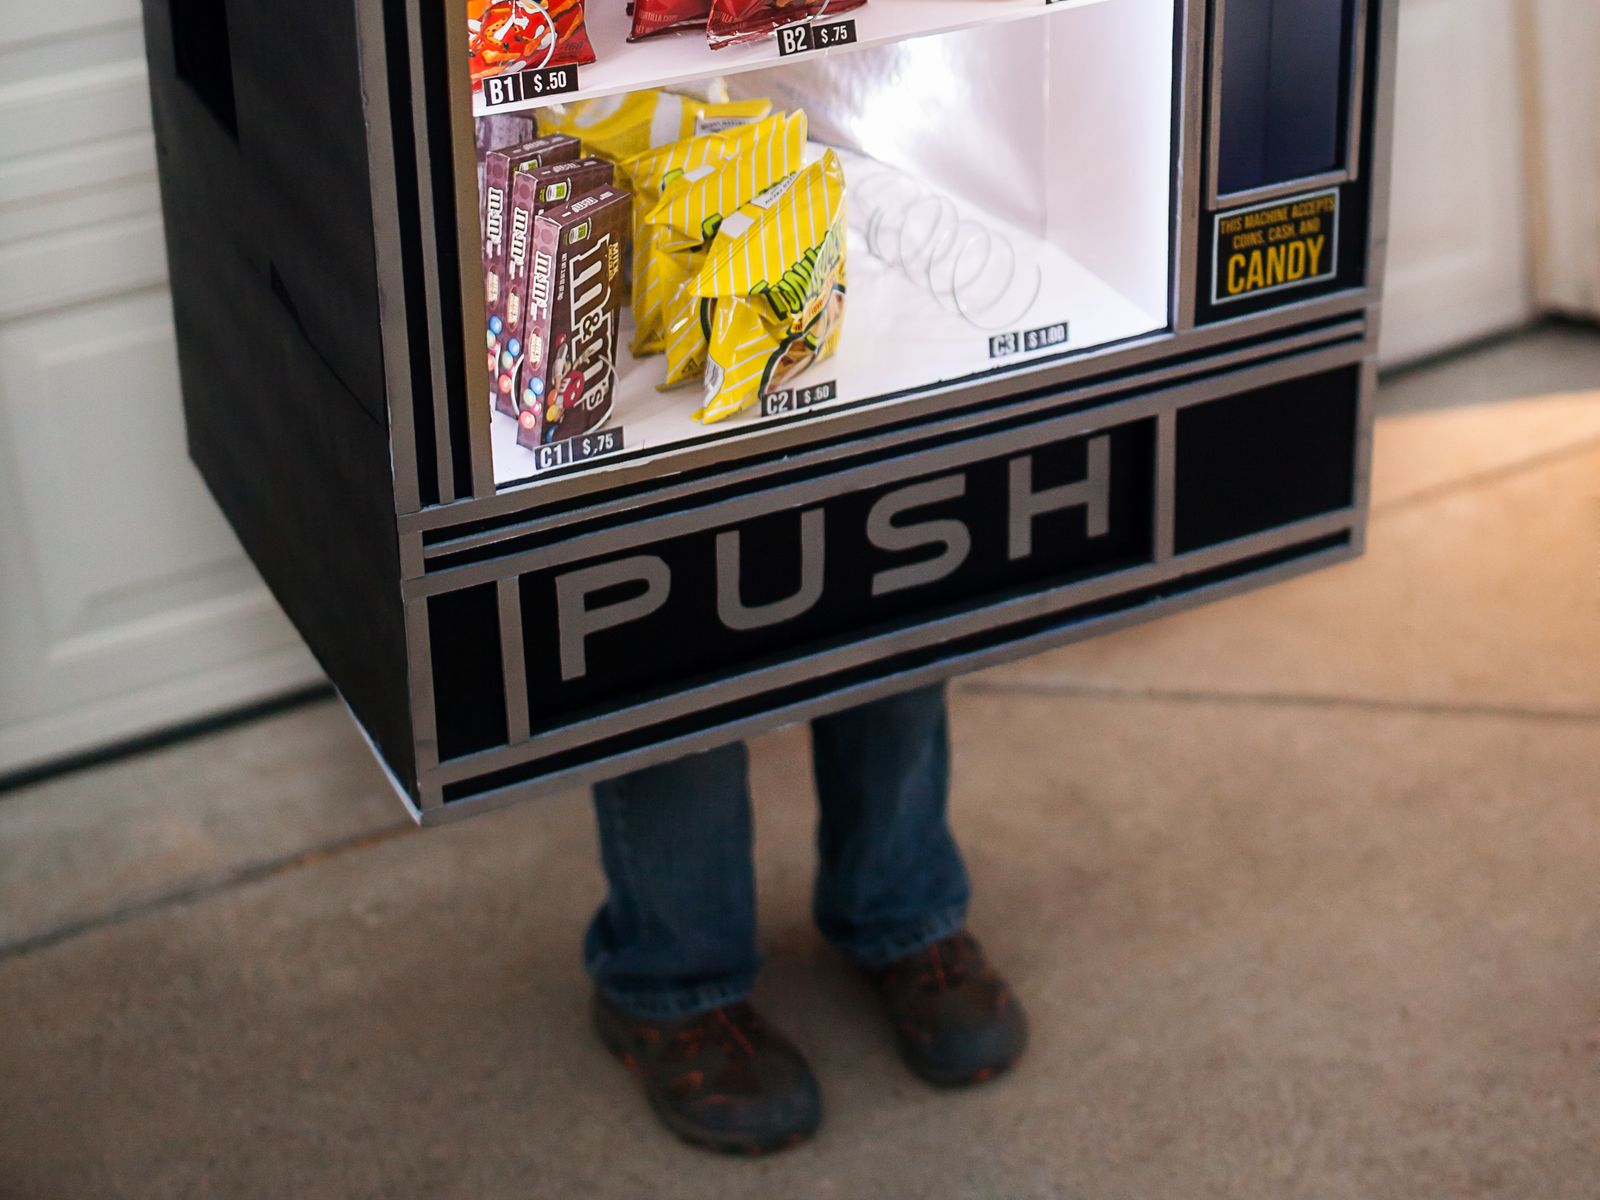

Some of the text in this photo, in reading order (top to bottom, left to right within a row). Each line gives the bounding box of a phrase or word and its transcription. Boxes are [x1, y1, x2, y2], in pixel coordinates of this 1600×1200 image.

[782, 27, 808, 54] B2
[488, 78, 514, 105] B1
[1227, 234, 1326, 295] CANDY
[767, 391, 789, 414] C2
[540, 444, 562, 468] C1
[555, 434, 1111, 682] PUSH
